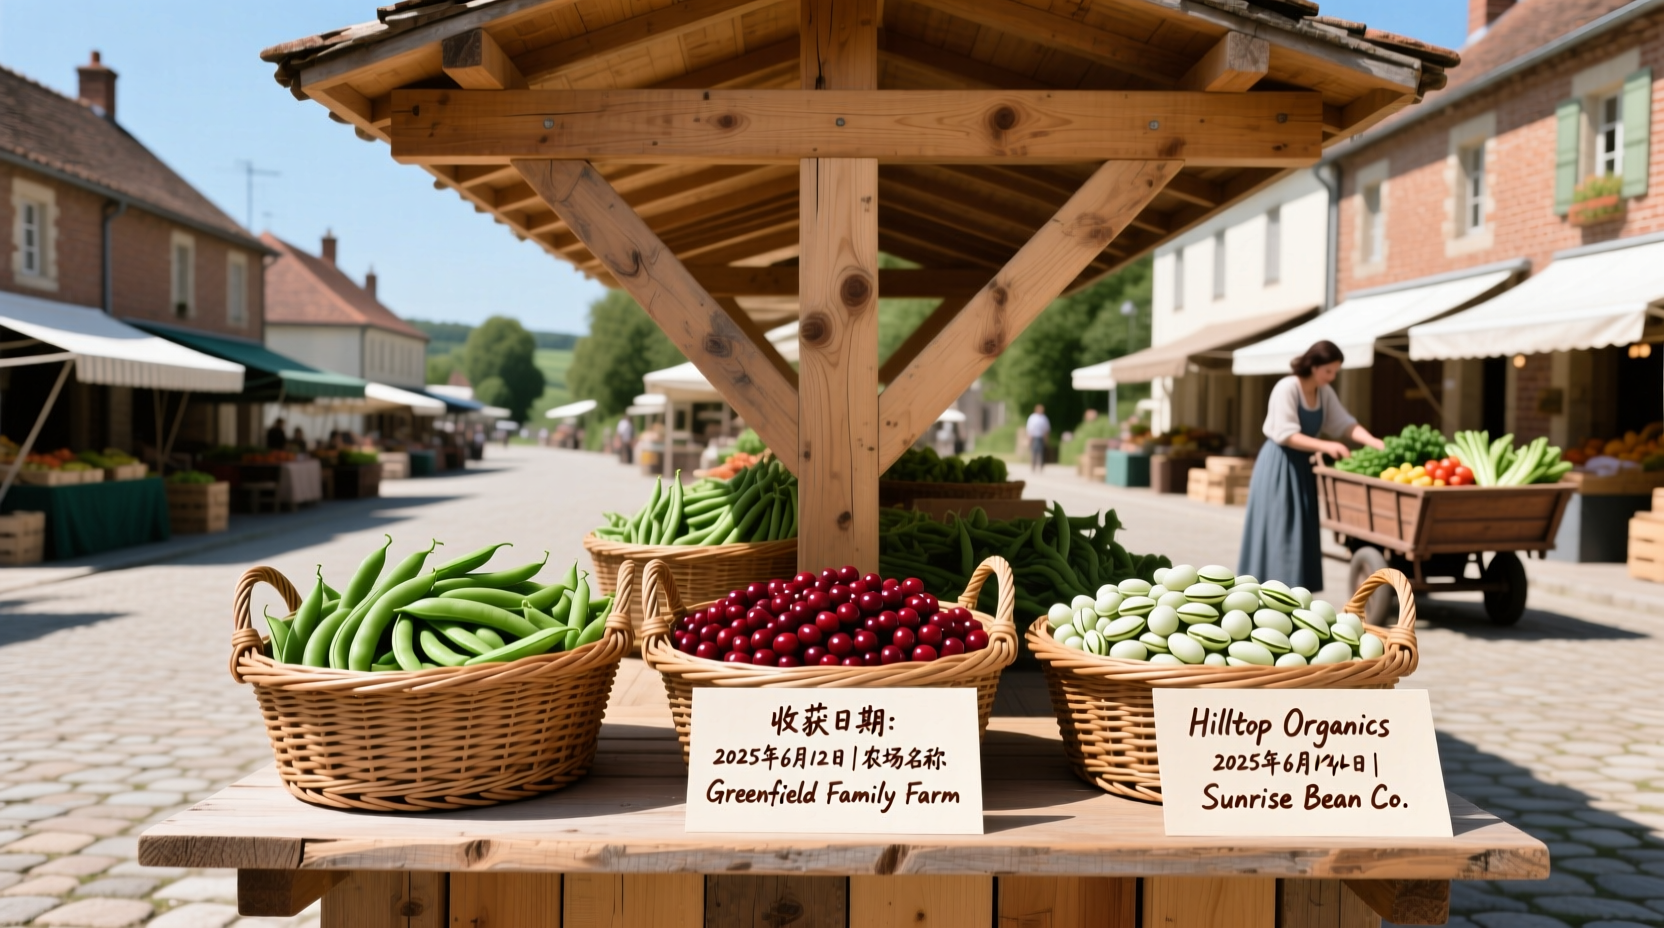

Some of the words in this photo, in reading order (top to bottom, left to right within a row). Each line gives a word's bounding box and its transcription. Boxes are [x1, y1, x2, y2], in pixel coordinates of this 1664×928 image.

[1188, 706, 1273, 747] Hilltop
[1283, 707, 1390, 749] Organics
[861, 745, 947, 771] 农场名称
[706, 778, 819, 808] Greenfield
[826, 780, 896, 814] Family
[905, 780, 960, 805] Farm
[1201, 782, 1294, 811] Sunrise
[1303, 783, 1362, 811] Bean
[1370, 783, 1409, 810] Co.
